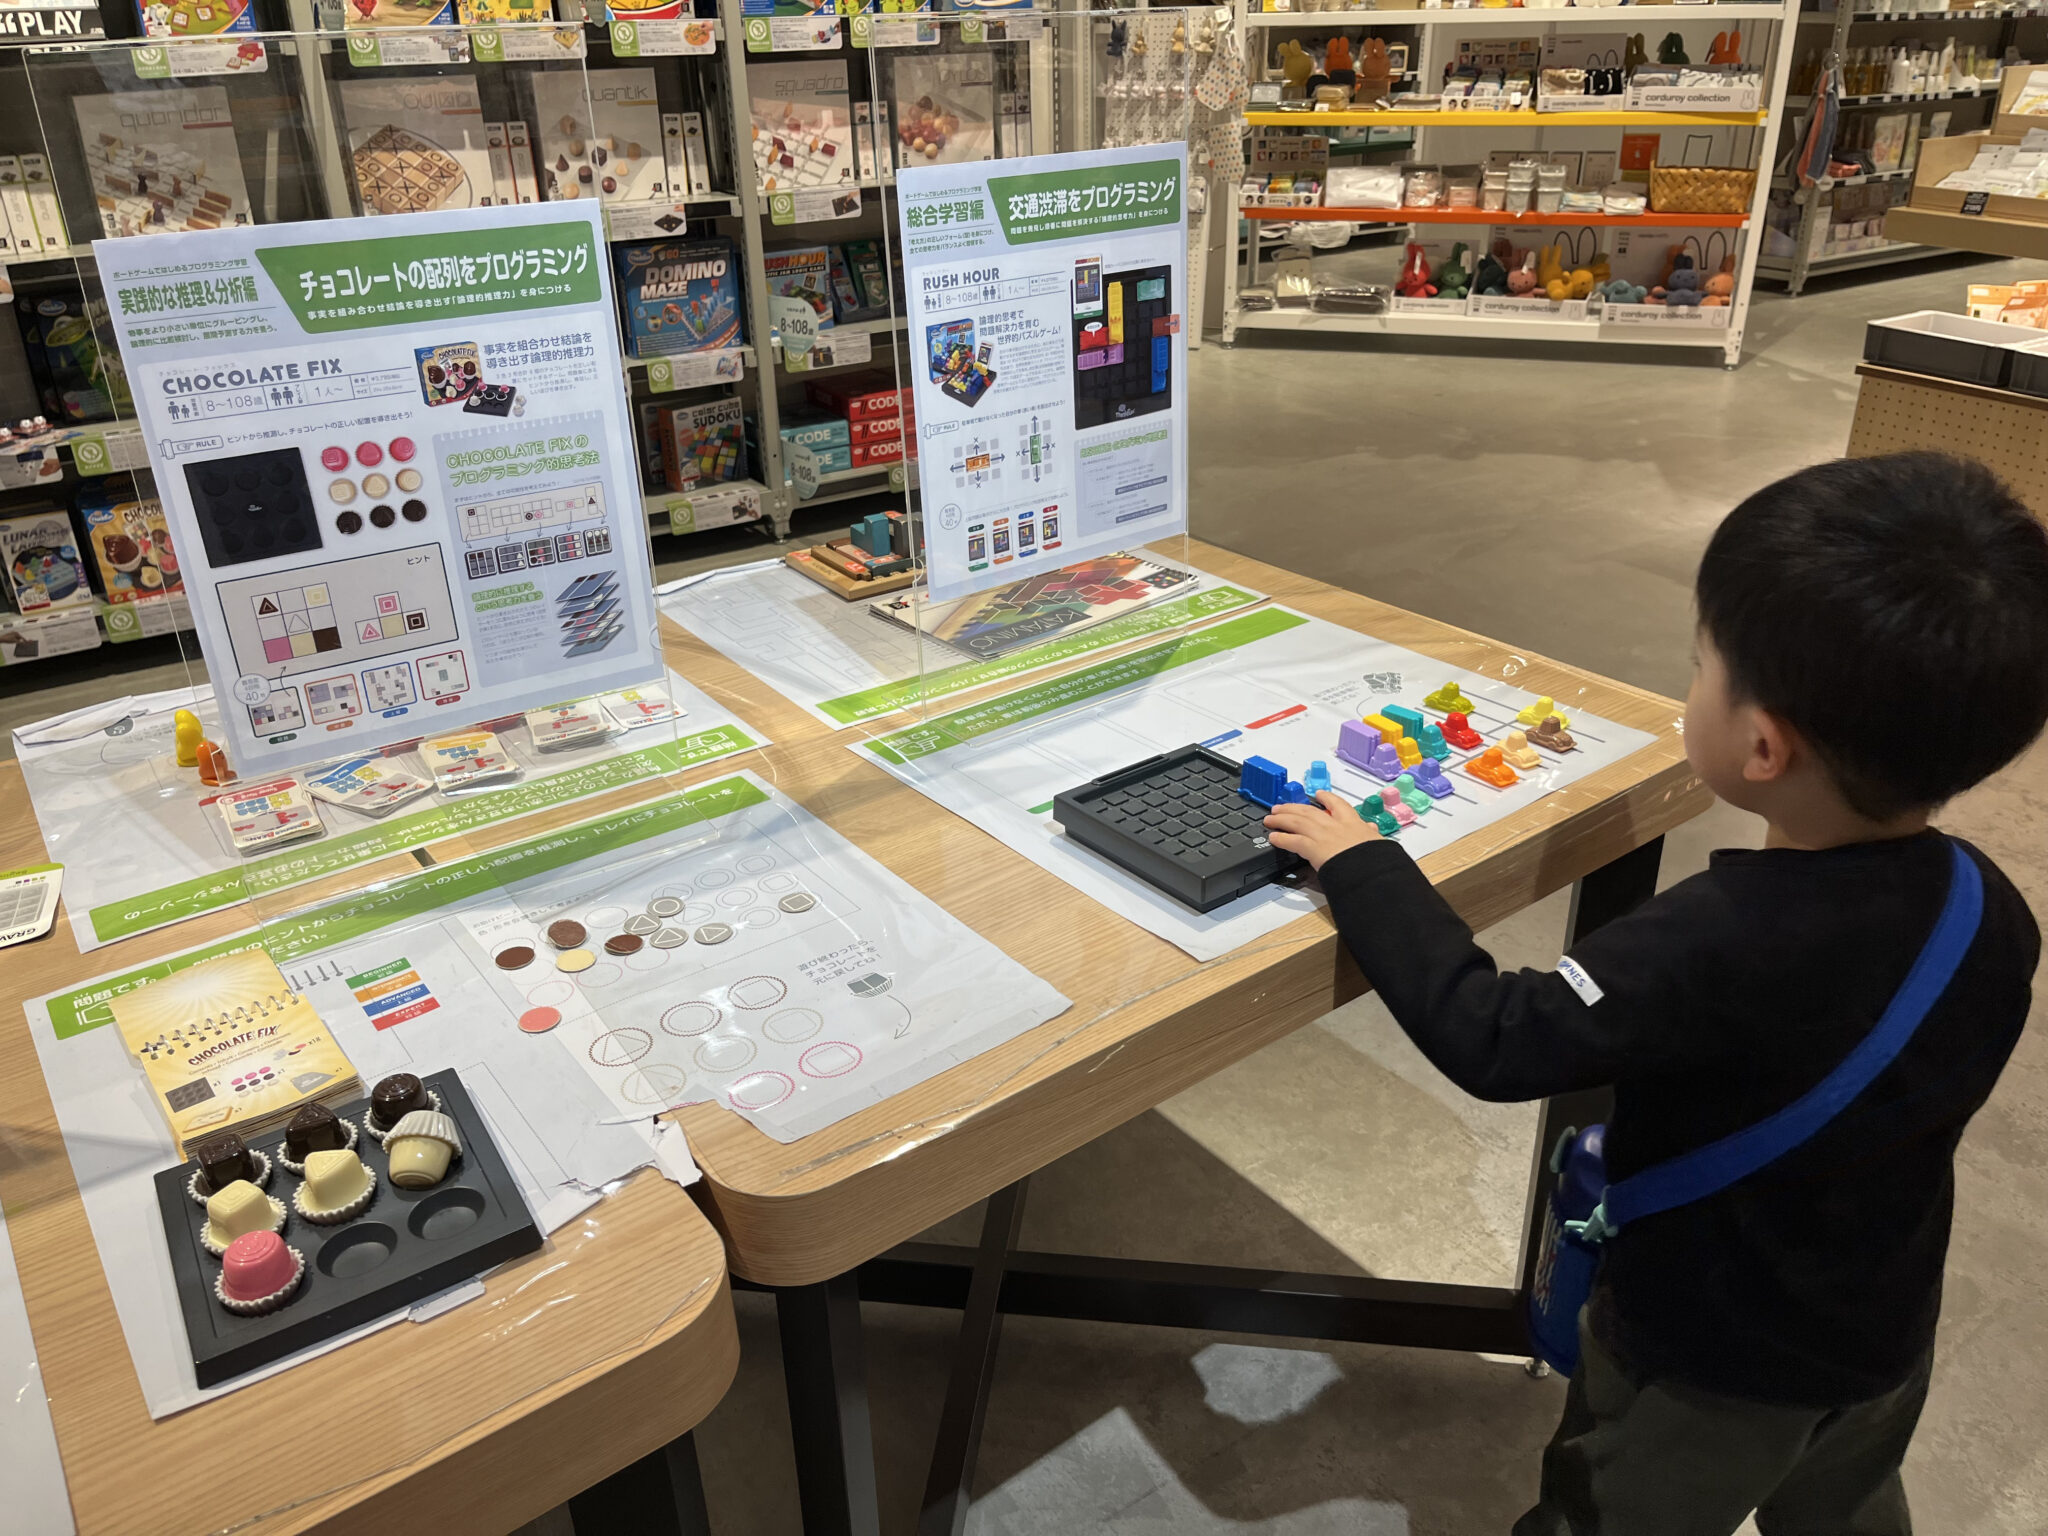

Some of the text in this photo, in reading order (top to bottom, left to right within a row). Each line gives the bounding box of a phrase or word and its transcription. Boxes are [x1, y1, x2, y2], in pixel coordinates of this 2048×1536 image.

[1645, 93, 1731, 106] corduroy collection
[1008, 176, 1177, 222] 交通渋滞をプログラミング
[906, 199, 985, 229] 総合学習編
[789, 251, 826, 267] HOUR
[299, 243, 589, 302] チョコレートの配列をプログラミング
[644, 258, 727, 285] DOMINO
[923, 267, 999, 291] RUSH HOUR
[640, 281, 688, 300] MAZE
[483, 332, 593, 356] 事実を組合わせ結論を
[485, 346, 595, 370] 導き出す論理的推理力
[162, 358, 344, 395] CHOCOLATE FIX
[693, 409, 741, 430] SUDOKU
[796, 429, 832, 446] CODE
[446, 440, 545, 470] CHOCOLATE
[549, 436, 573, 451] FIX
[449, 450, 601, 488] プログラミング的思考法
[406, 553, 432, 567] ヒント
[362, 960, 402, 978] BEGINNER
[805, 945, 877, 979] チョコレートを
[380, 986, 422, 1005] ADVANCED
[395, 1002, 426, 1017] EXPERT
[188, 1024, 283, 1068] CHOCOLATE FIX
